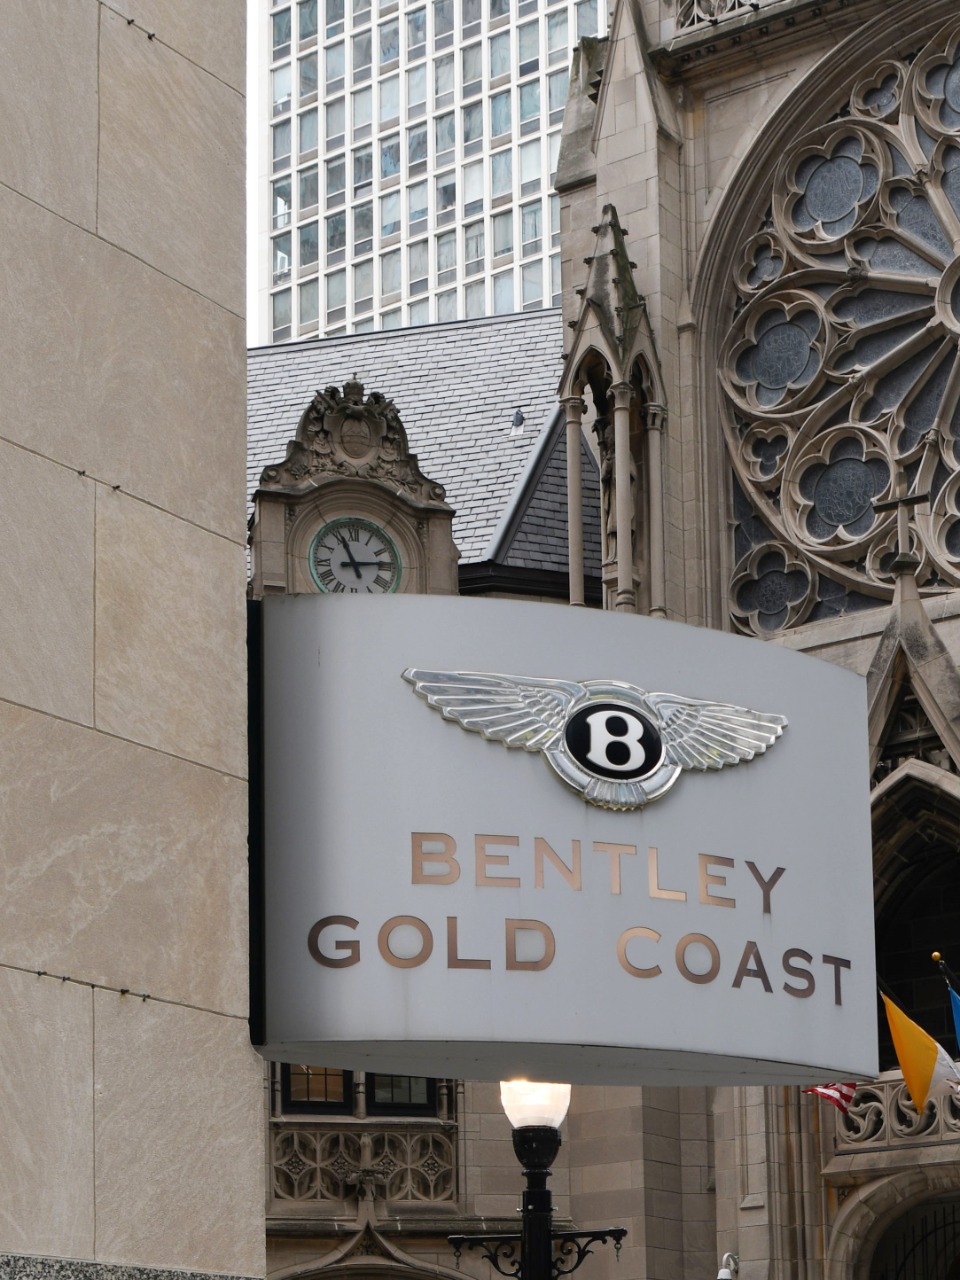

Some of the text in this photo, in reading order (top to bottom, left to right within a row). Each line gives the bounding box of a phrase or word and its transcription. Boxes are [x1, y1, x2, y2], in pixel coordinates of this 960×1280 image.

[587, 710, 645, 772] B
[410, 831, 787, 915] BENTLEY
[307, 914, 852, 1006] GOLD COAST
